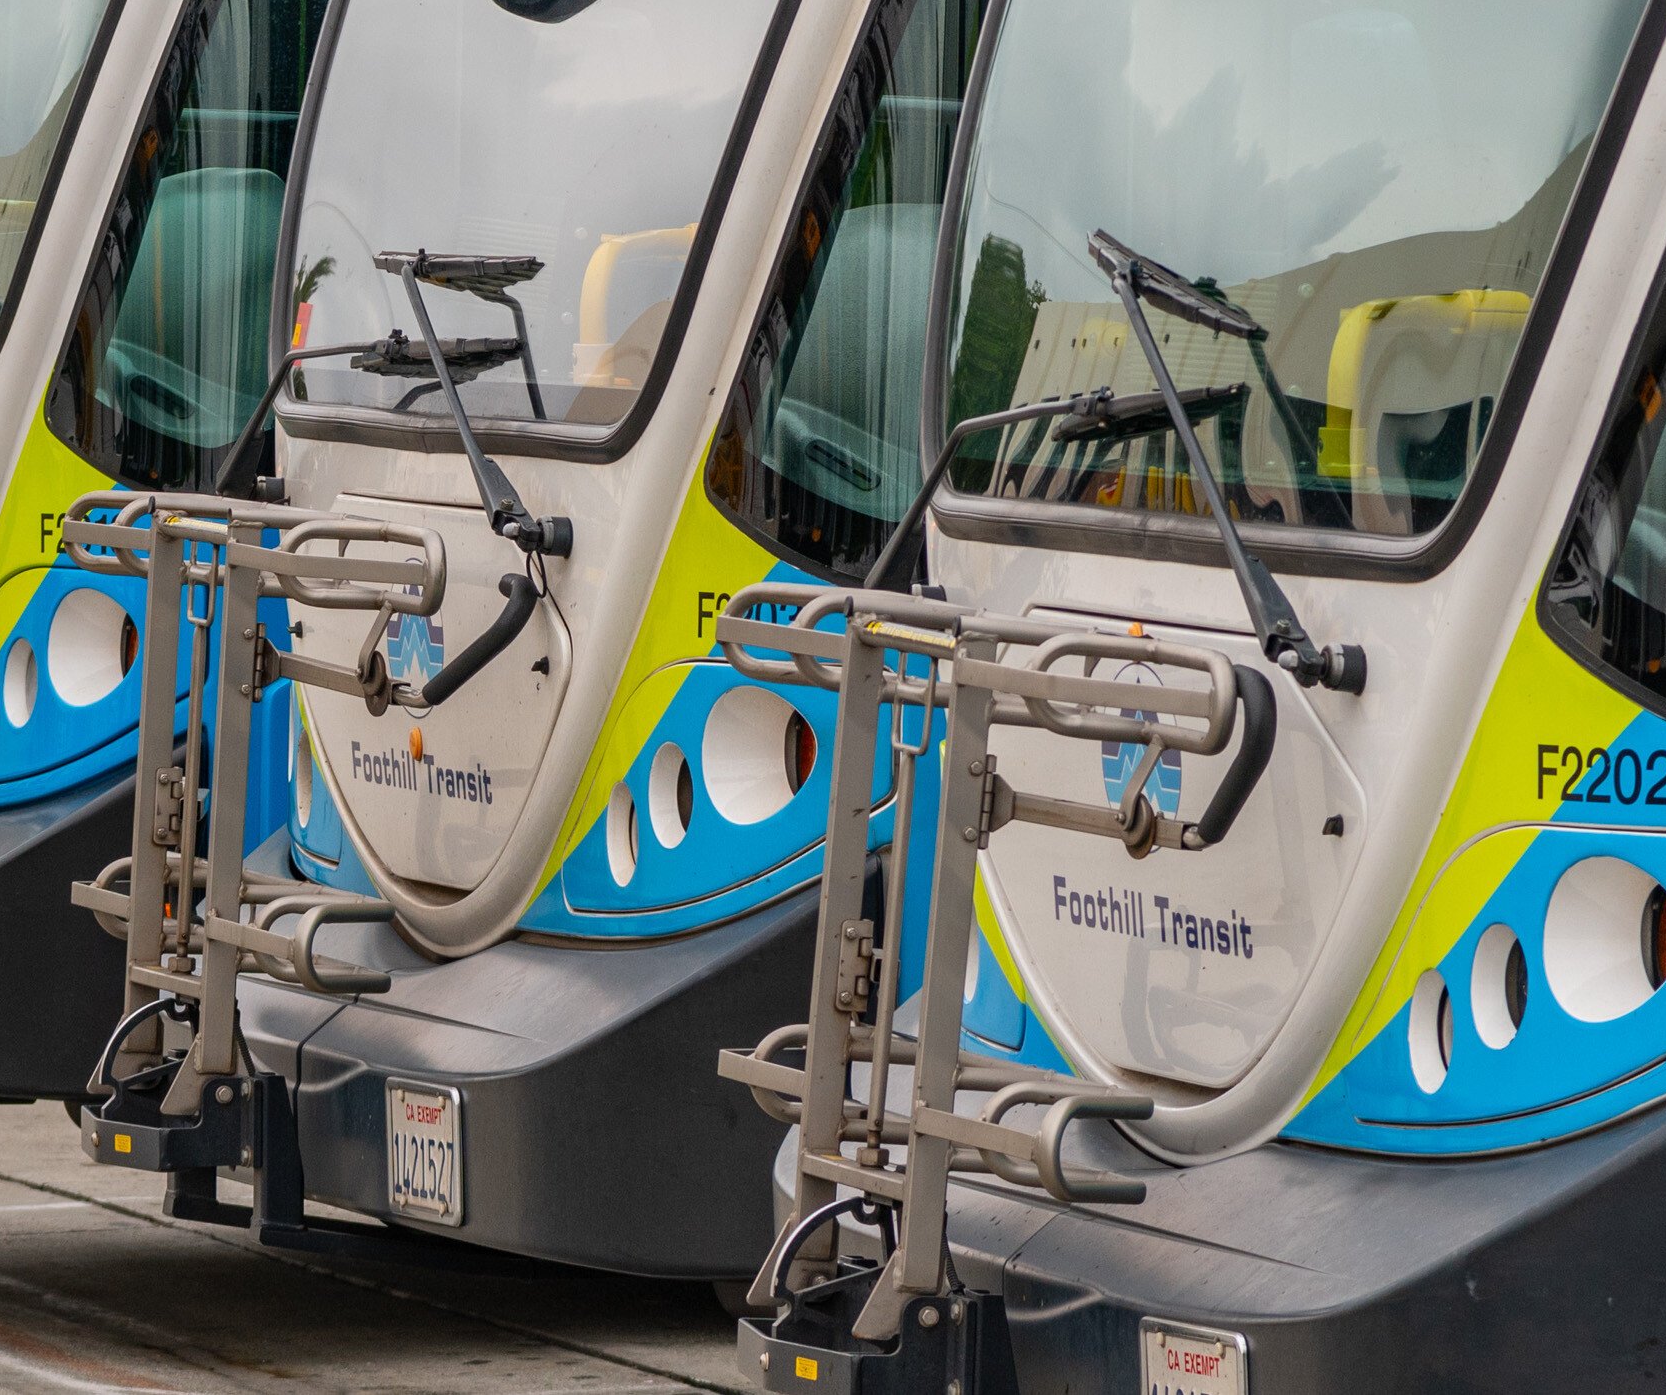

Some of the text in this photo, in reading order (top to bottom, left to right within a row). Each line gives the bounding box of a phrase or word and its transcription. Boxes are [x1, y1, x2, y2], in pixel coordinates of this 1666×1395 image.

[351, 740, 493, 805] Foothill Transit
[1053, 875, 1253, 959] Foothill Transit
[406, 1103, 442, 1125] CA EXEMPT
[395, 1132, 454, 1204] 1421527
[1167, 1349, 1220, 1377] CA EXEMPT
